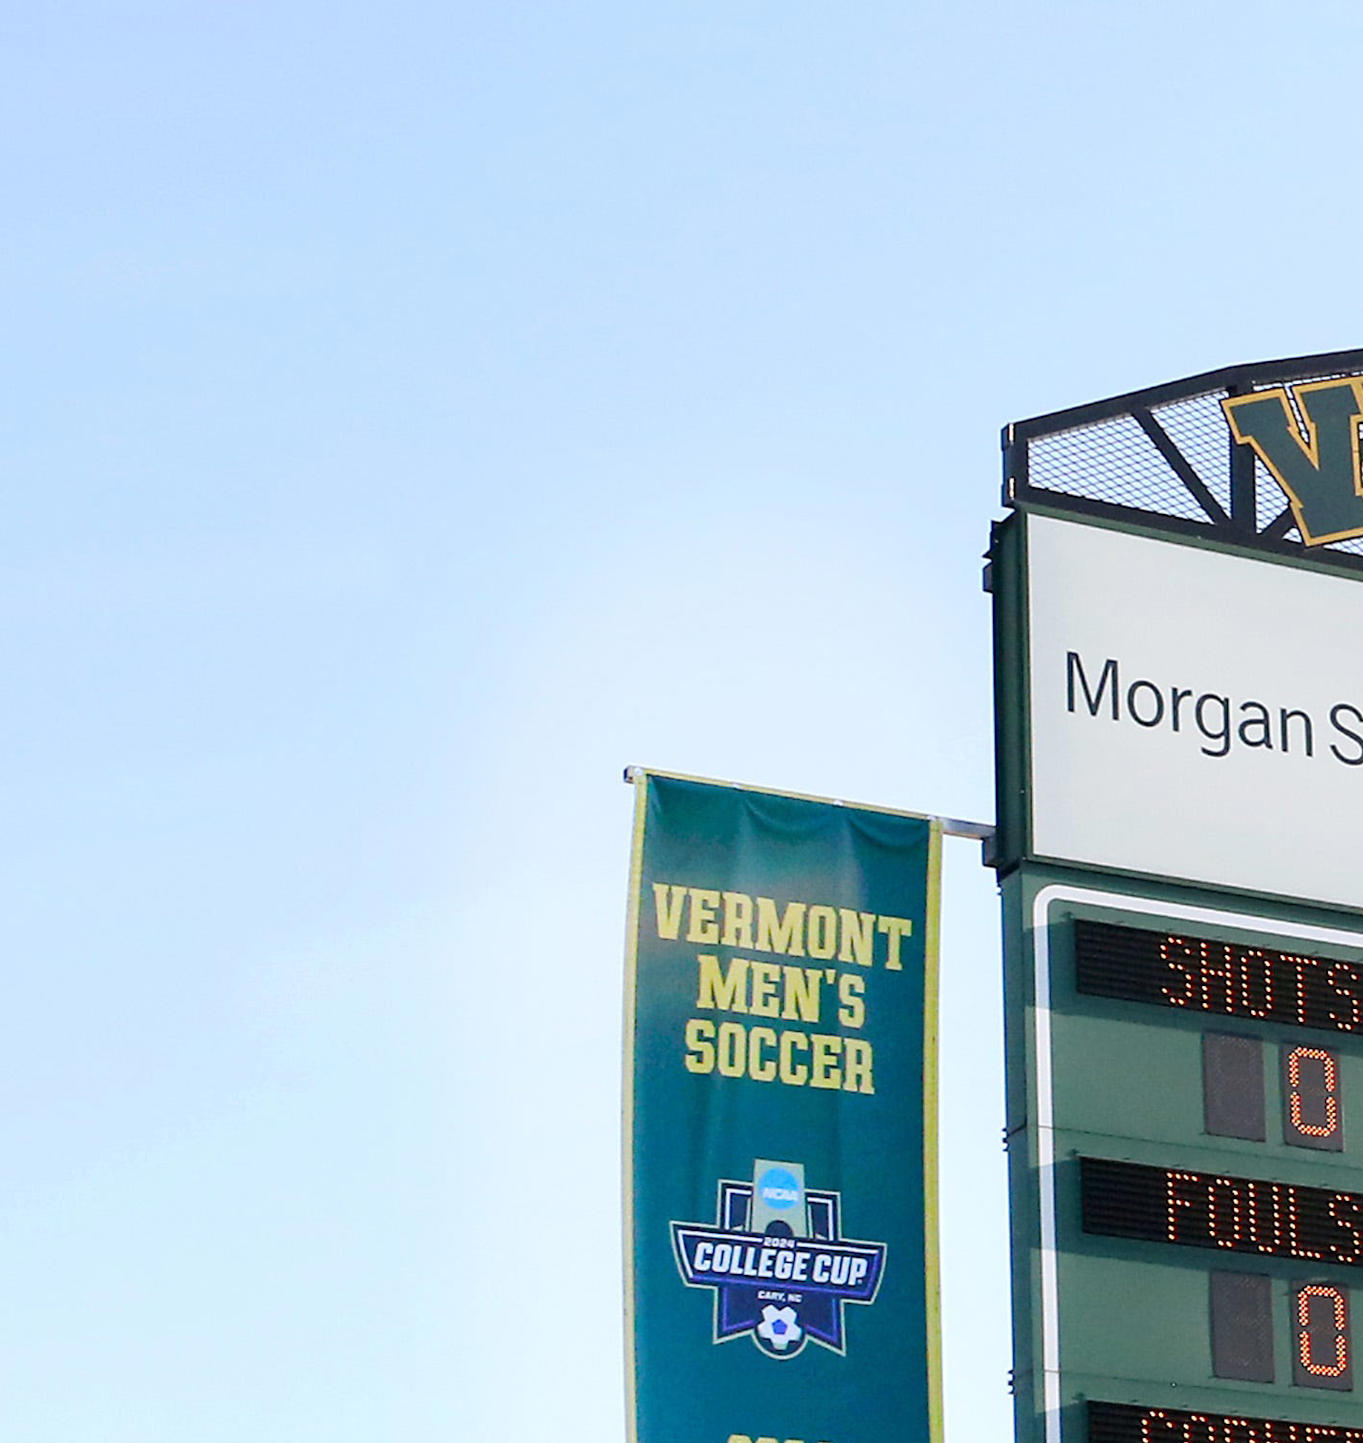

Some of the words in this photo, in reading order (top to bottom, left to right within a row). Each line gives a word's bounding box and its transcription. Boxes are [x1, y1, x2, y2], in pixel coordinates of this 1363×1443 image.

[1064, 650, 1316, 759] Morgan
[652, 882, 913, 971] VERMONT
[696, 954, 866, 1029] MEN'S
[1159, 937, 1361, 1031] SHOTS
[684, 1018, 875, 1095] SOCCER
[1288, 1045, 1336, 1138] 0
[763, 1236, 796, 1249] 2024
[1163, 1170, 1362, 1264] FOULS
[693, 1242, 812, 1282] COLLEGE
[812, 1253, 868, 1287] CUP
[757, 1290, 786, 1302] CARY,
[787, 1293, 803, 1303] NC
[1297, 1283, 1349, 1379] 0
